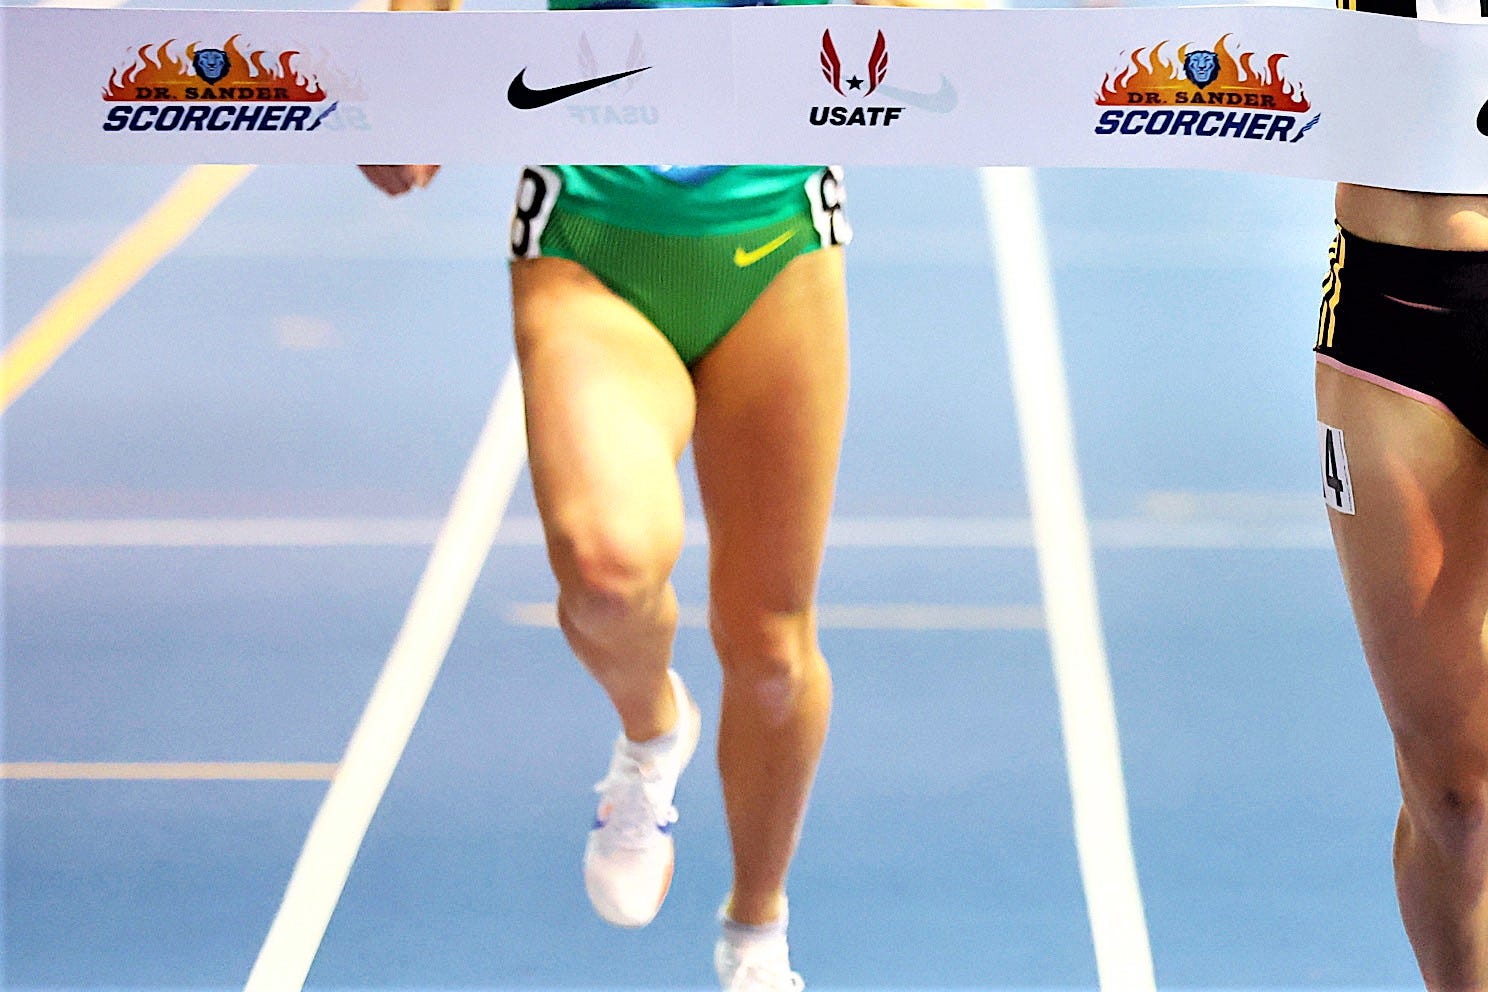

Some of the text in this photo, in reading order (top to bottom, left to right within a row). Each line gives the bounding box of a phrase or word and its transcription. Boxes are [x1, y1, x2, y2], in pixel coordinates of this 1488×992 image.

[135, 86, 290, 100] DR. SANDER
[1127, 91, 1276, 107] DR. SANDER
[102, 105, 312, 131] SCORCHER
[809, 106, 903, 126] USATF
[1094, 109, 1296, 142] SCORCHER
